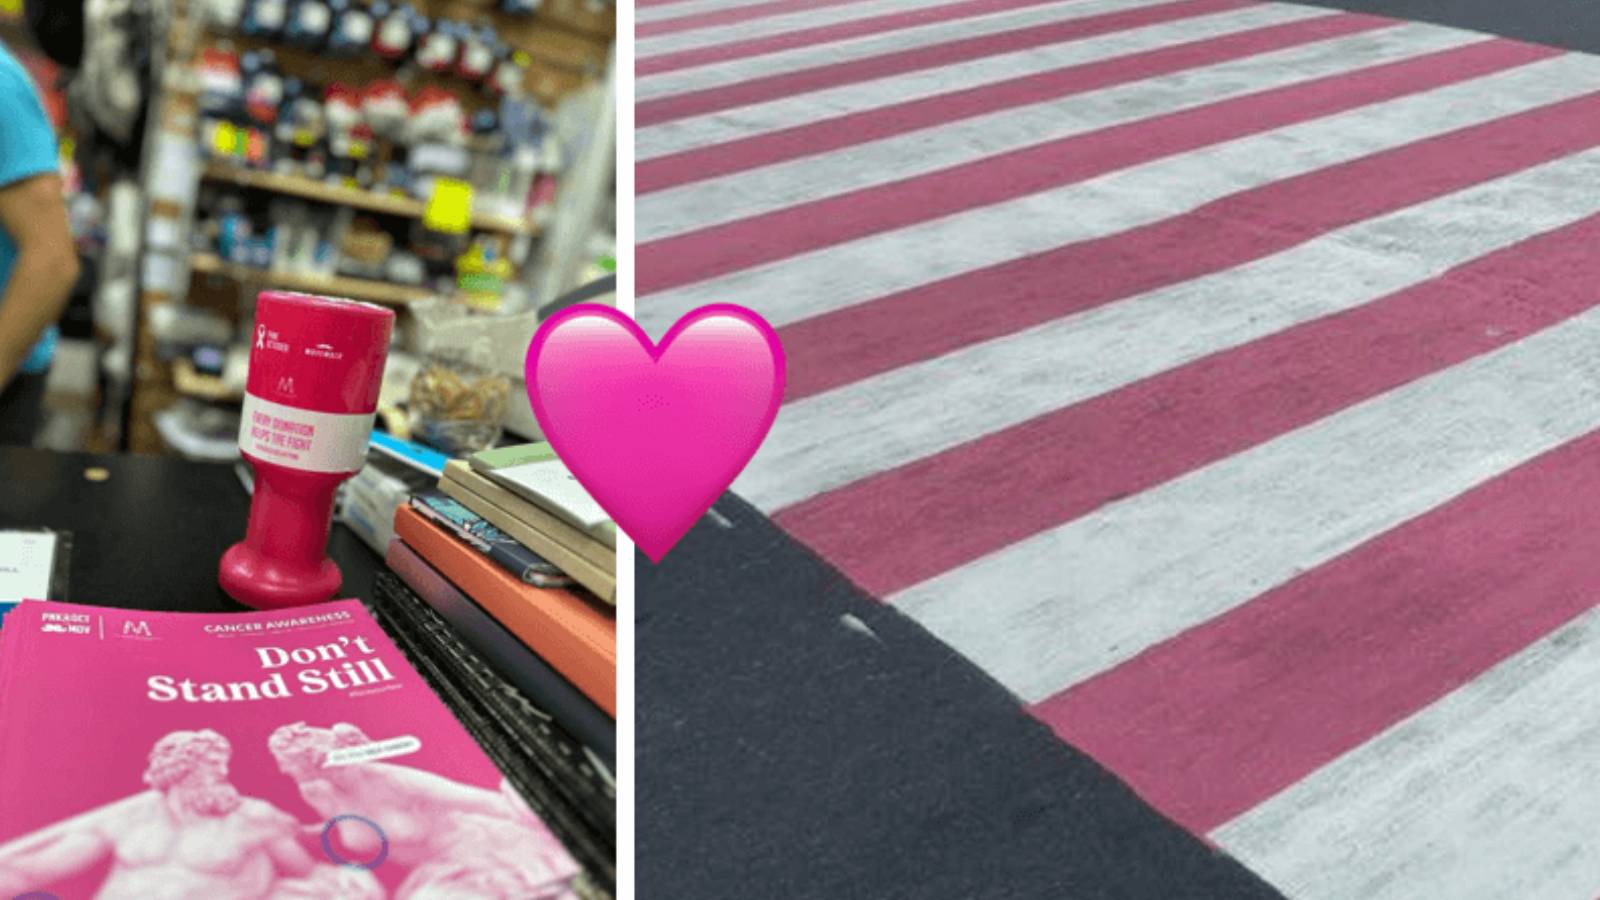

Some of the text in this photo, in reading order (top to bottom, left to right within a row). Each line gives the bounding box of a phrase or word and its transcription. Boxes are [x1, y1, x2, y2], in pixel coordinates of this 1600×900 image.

[203, 621, 263, 634] CANCER
[266, 610, 352, 630] AWARENESS
[147, 674, 292, 703] Stand
[297, 657, 396, 694] Still
